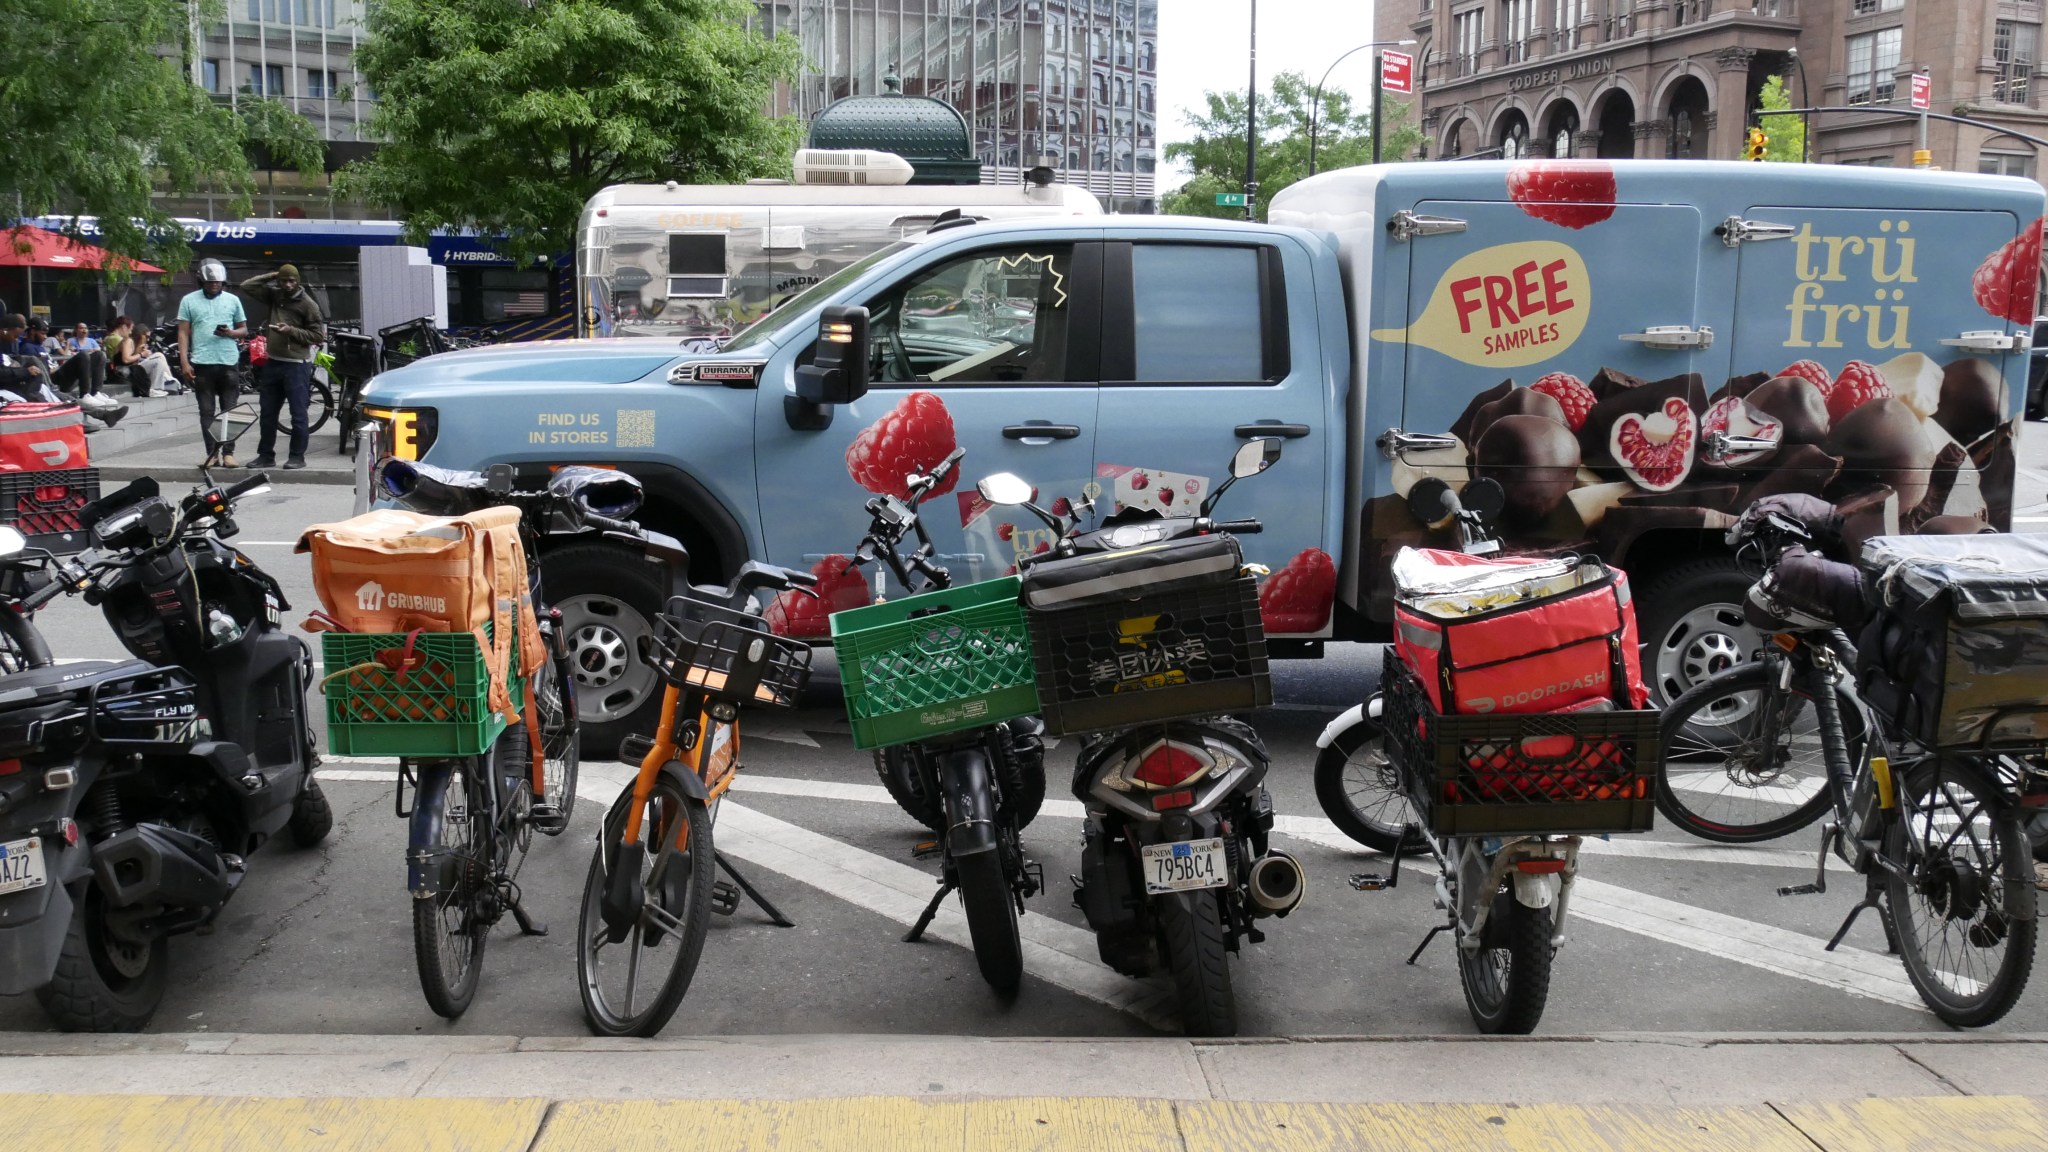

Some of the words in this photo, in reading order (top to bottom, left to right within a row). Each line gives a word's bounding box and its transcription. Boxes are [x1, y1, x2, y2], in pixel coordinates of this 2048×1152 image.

[1507, 69, 1559, 91] COOPER
[1568, 58, 1611, 78] UNION
[657, 212, 744, 228] COFFEE
[216, 223, 257, 239] bus
[1791, 219, 1918, 283] trü
[1450, 258, 1575, 334] FREE
[1782, 282, 1912, 349] frü
[1483, 323, 1560, 355] SAMPLES
[538, 413, 575, 425] FIND
[580, 413, 600, 425] US
[529, 431, 545, 444] IN
[550, 431, 609, 444] STORES
[387, 592, 446, 613] GRUBHUB
[1502, 671, 1607, 708] DOORDASH
[155, 706, 177, 717] FLY
[7, 846, 29, 855] YORK
[1153, 849, 1172, 858] NEW
[1190, 844, 1213, 853] YORK
[1155, 853, 1214, 883] 795BC4
